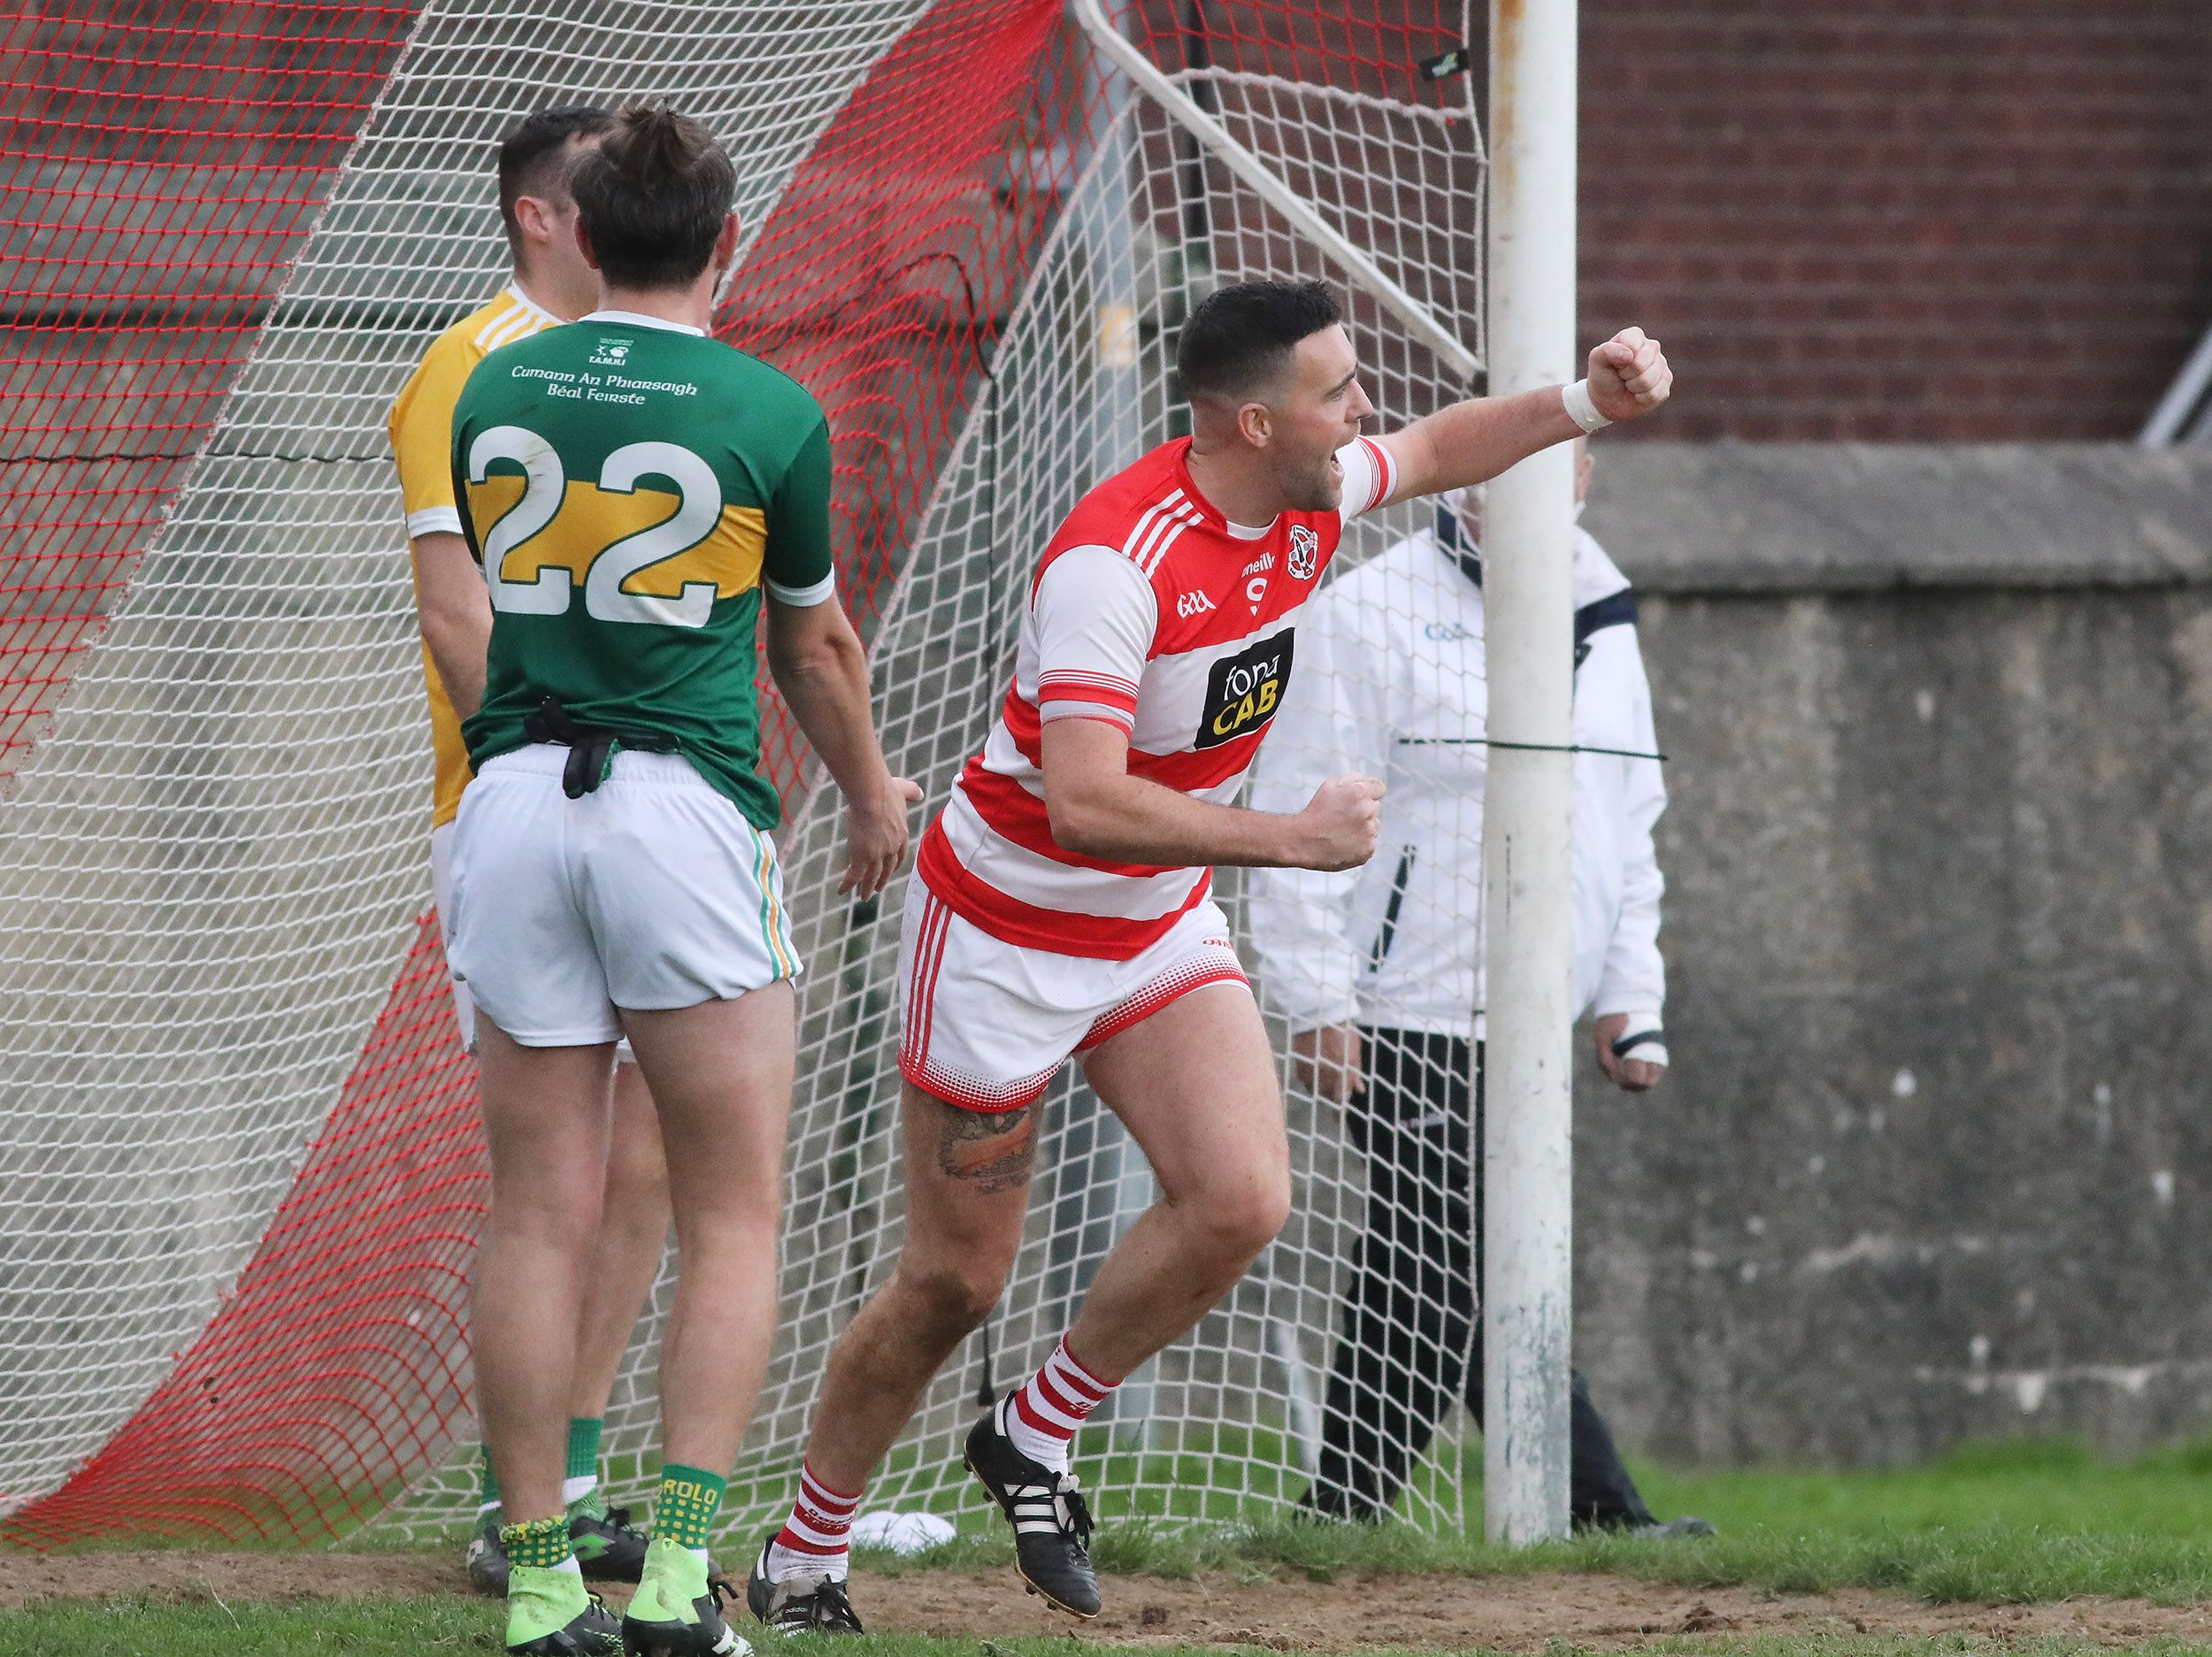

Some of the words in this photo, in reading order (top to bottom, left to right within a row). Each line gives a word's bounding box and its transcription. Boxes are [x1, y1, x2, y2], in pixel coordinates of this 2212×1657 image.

[511, 365, 575, 383] Cumann
[579, 372, 601, 386] An
[606, 375, 697, 396] Phiarsaigh
[547, 383, 581, 399] Béal
[587, 388, 645, 405] Feirste
[469, 426, 721, 628] 22
[1177, 589, 1217, 618] GAA
[1224, 654, 1280, 702] fona
[1212, 679, 1279, 735] CAB
